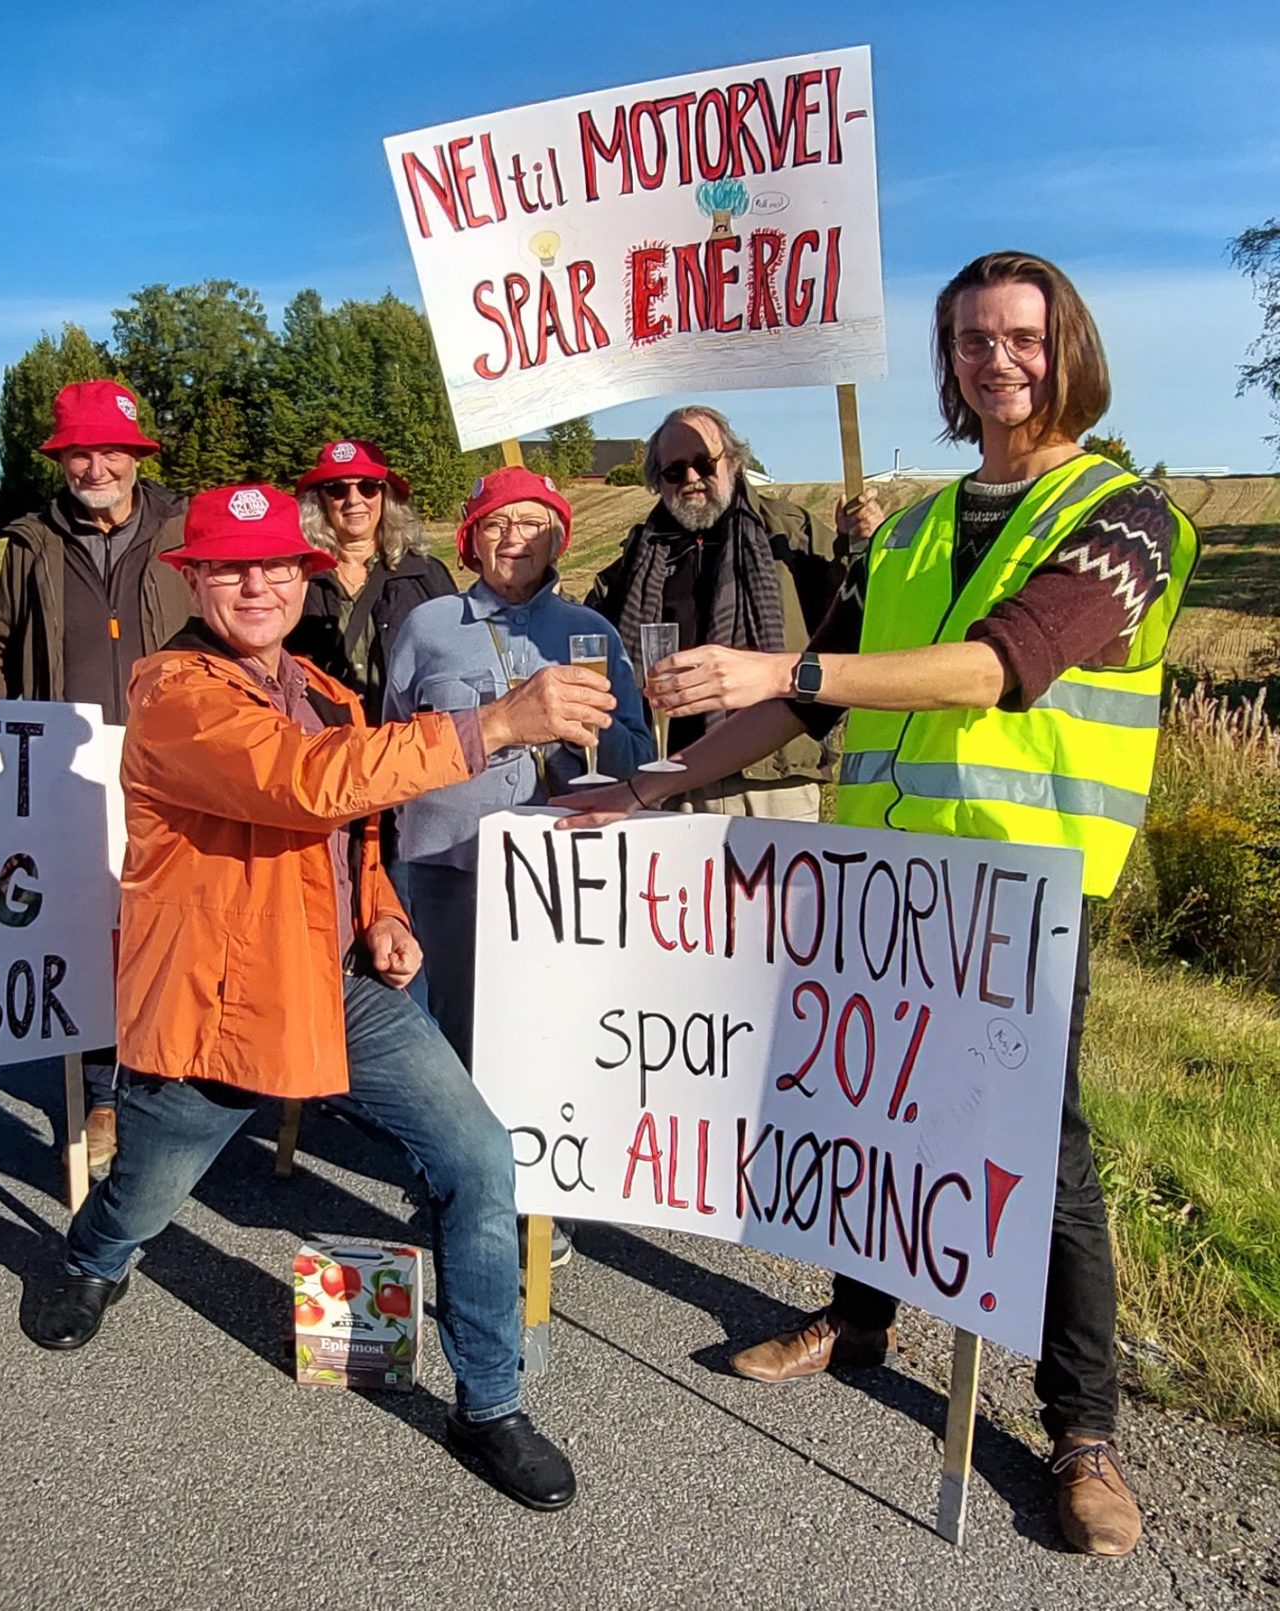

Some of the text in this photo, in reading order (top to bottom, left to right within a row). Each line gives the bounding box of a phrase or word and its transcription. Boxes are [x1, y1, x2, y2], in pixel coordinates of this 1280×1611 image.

[402, 67, 868, 238] NEI til MOTORVEI-
[473, 226, 842, 381] SPAR ENERGI
[502, 829, 1072, 1016] NEI til MOTORVEI-
[593, 979, 932, 1125] spar 20%
[622, 1111, 718, 1216] ALL
[734, 1117, 1024, 1313] KJØRING!
[320, 1338, 385, 1355] Eplemost
